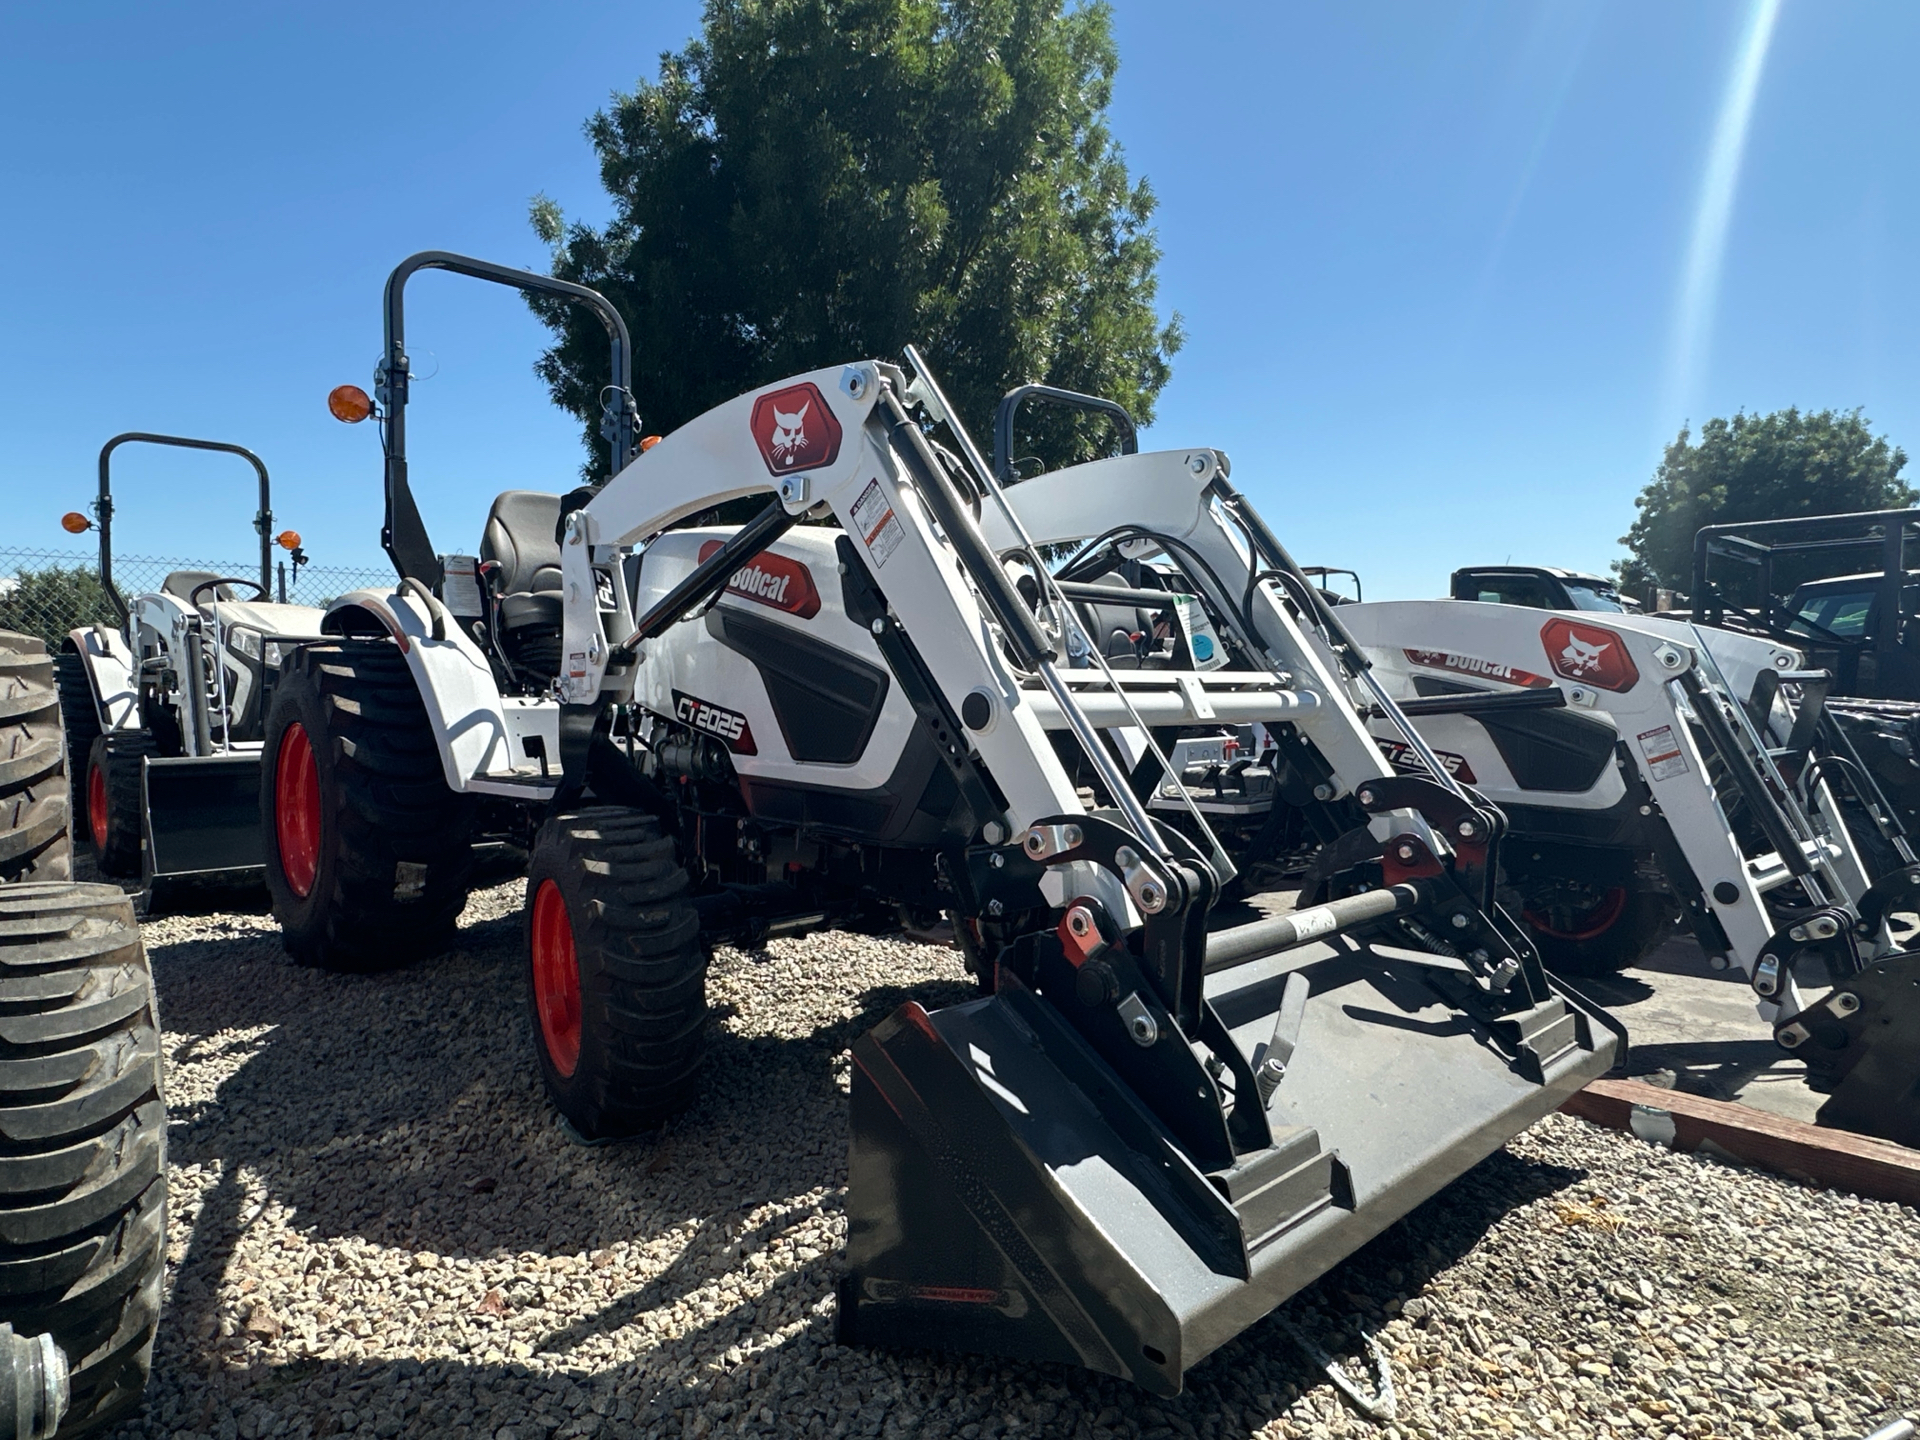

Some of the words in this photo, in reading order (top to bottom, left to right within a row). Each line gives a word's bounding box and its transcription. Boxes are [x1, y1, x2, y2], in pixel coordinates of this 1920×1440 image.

[595, 569, 616, 606] FL7
[729, 565, 790, 603] Bobcat
[677, 697, 746, 740] CT2025
[1377, 741, 1464, 774] T25
